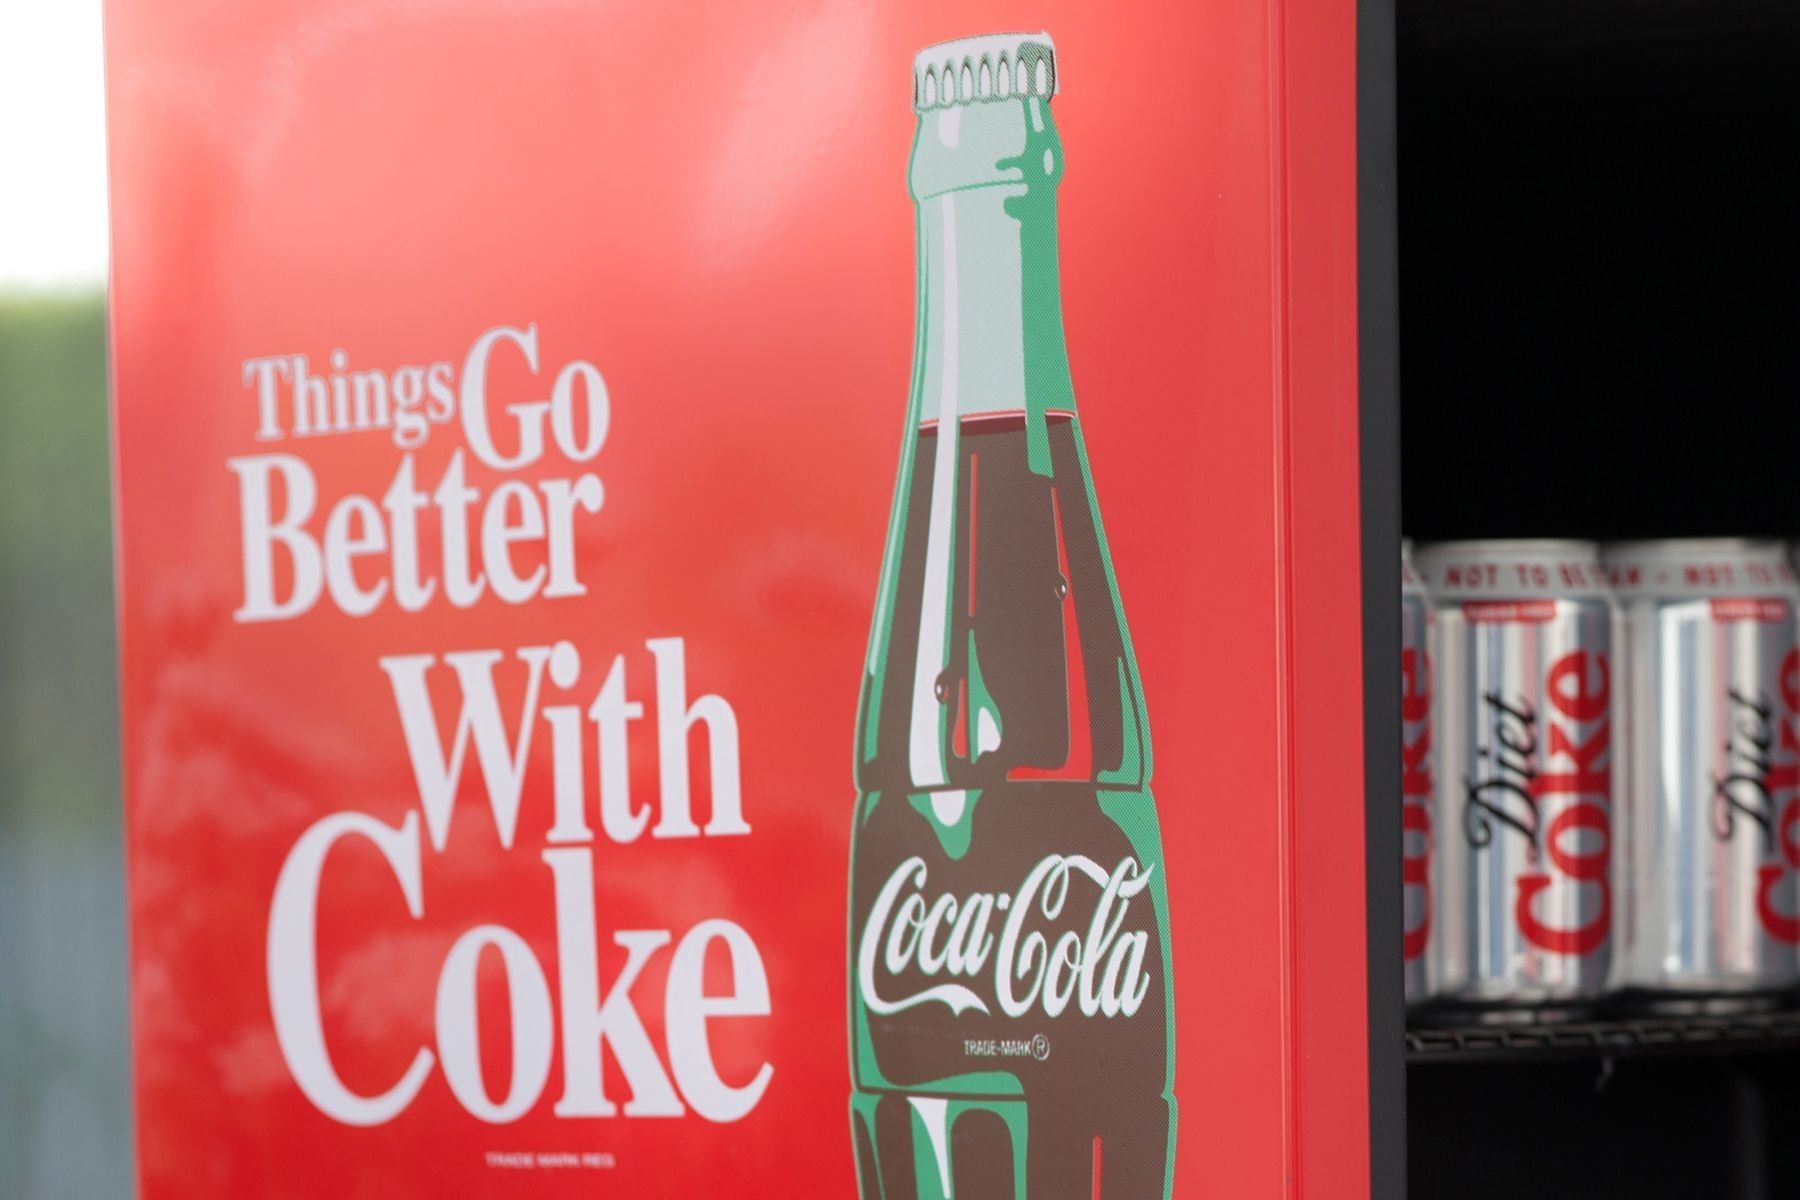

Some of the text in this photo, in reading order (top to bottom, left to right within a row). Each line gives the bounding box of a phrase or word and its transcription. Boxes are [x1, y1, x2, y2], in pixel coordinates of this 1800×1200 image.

[243, 325, 610, 471] Things Go
[228, 446, 605, 622] Better
[1445, 563, 1498, 587] NOT
[380, 636, 752, 852] With
[1464, 690, 1538, 864] Diet
[1515, 649, 1611, 957] Coke
[1712, 687, 1774, 853] Diet
[266, 811, 774, 1127] Coke
[859, 853, 1155, 1018] Coca-Cola
